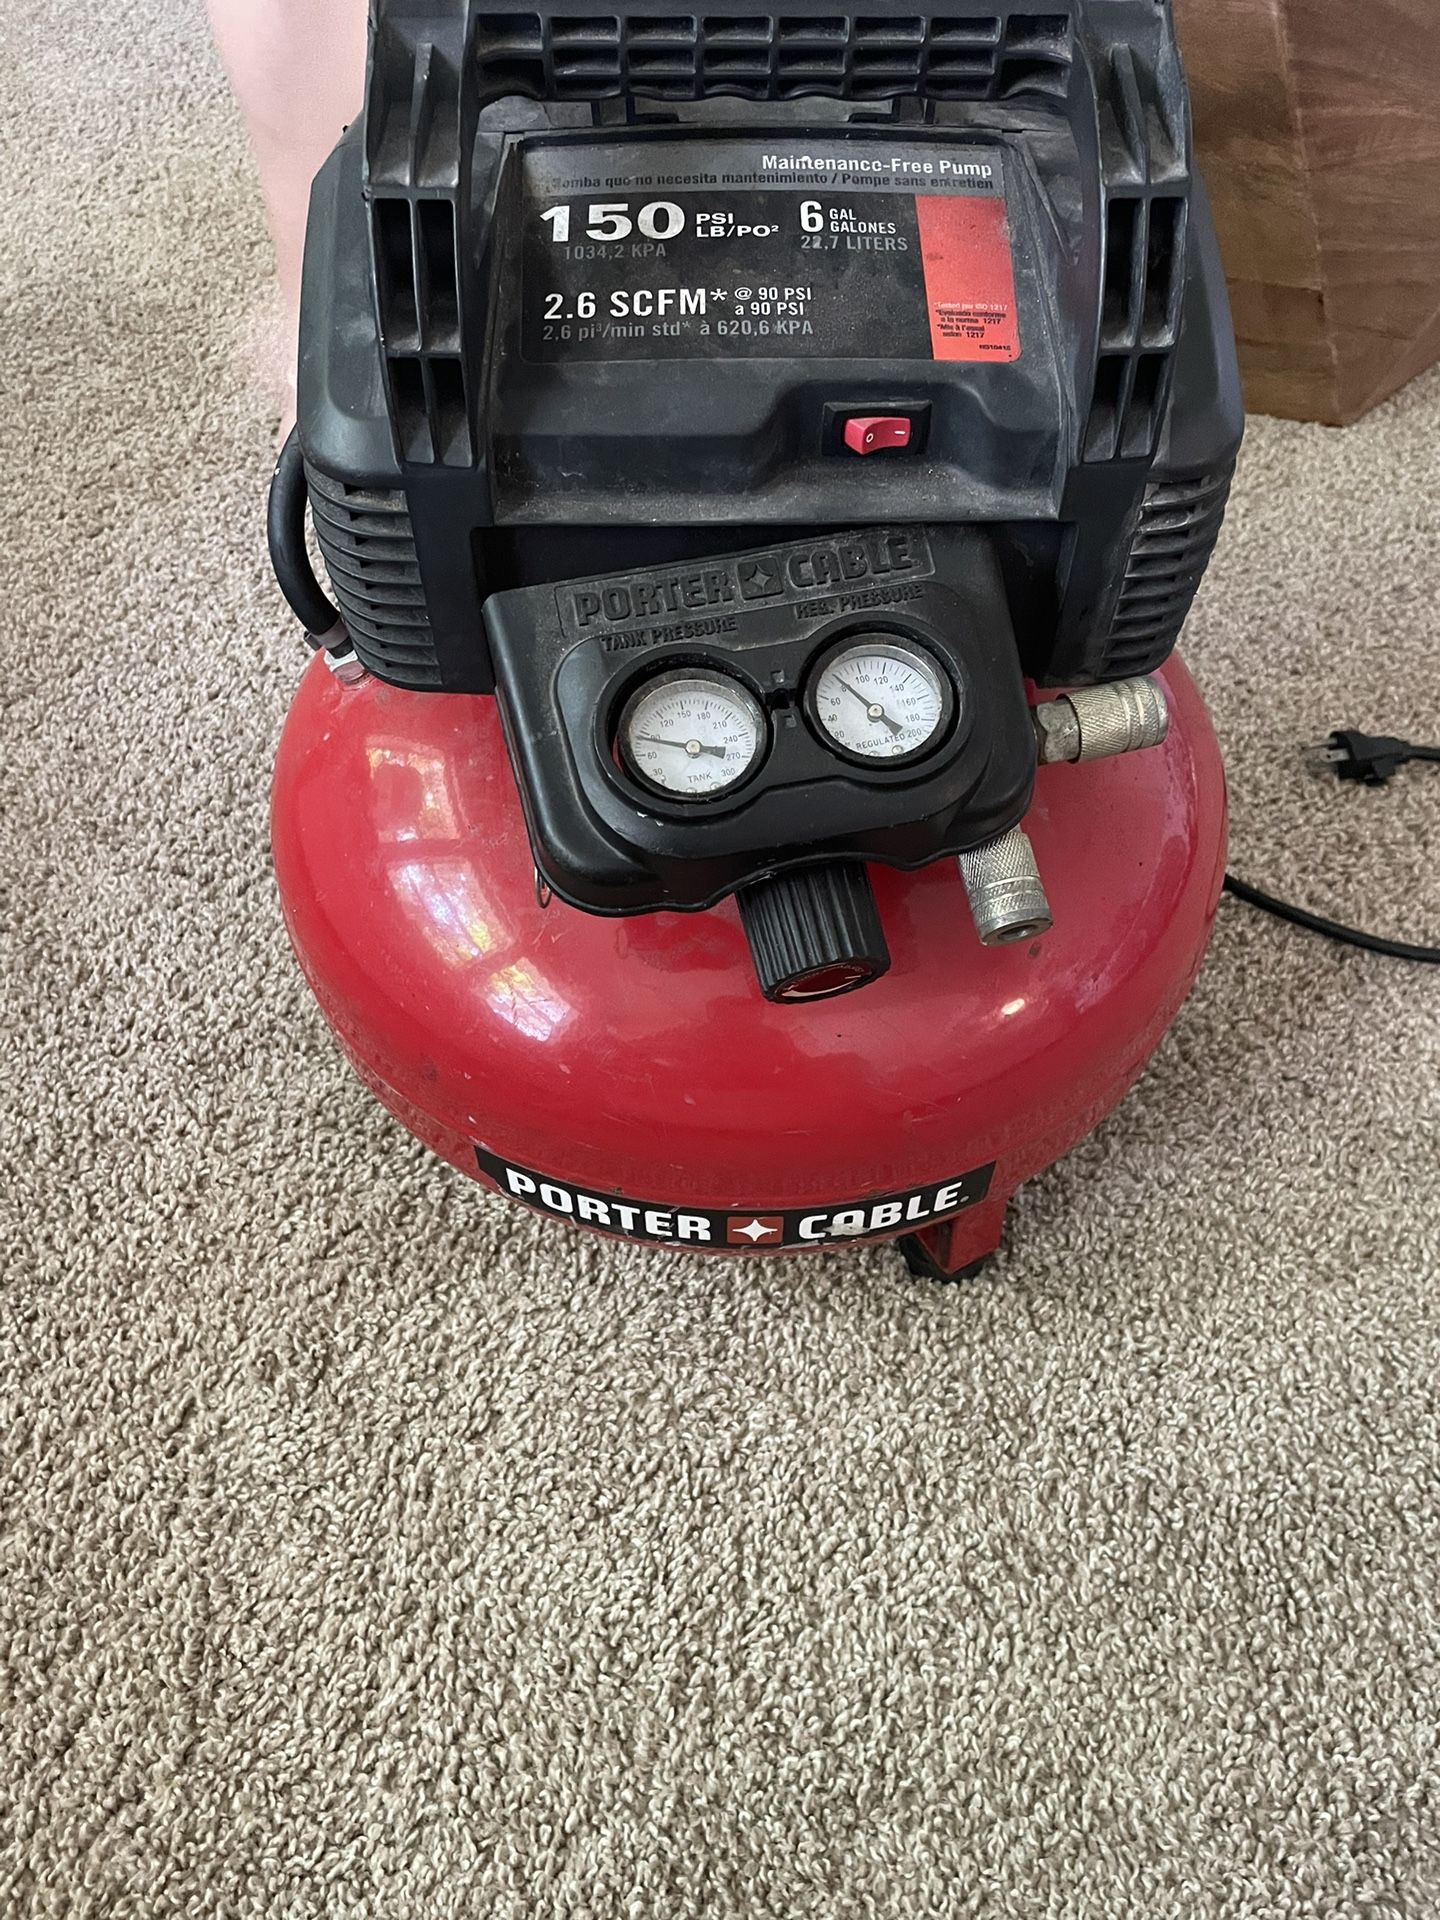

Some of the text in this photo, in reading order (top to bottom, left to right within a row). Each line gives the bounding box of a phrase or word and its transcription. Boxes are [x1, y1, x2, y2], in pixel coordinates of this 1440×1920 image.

[762, 155, 992, 178] Maintenance-Free Pump
[605, 175, 631, 189] que
[635, 175, 653, 186] no
[657, 173, 717, 186] necesita
[722, 171, 828, 185] mantenimiento
[842, 173, 890, 188] Pompe
[895, 176, 926, 187] sans
[931, 176, 993, 190] entretien
[696, 213, 734, 225] PSI
[800, 200, 824, 233] 6
[830, 209, 857, 221] GAL
[540, 201, 686, 242] 150
[830, 221, 896, 234] GALONES
[846, 236, 908, 251] LITERS
[564, 243, 667, 261] 1034,2 KPA
[734, 287, 812, 300] @ 90 PSI
[543, 292, 596, 320] 2.6
[735, 302, 805, 316] a 90 PSI
[543, 325, 571, 341] 2,6
[700, 319, 711, 335] à
[717, 320, 770, 337] 620,6
[776, 319, 814, 335] KPA
[574, 537, 914, 627] PORTER CABLE
[840, 584, 924, 613] PRESSURE
[601, 616, 737, 651] TANK PRESSURE
[856, 674, 870, 684] 100
[874, 676, 888, 686] 120
[890, 684, 904, 692] 140
[831, 697, 840, 706] 60
[902, 697, 916, 706] 160
[677, 710, 691, 718] 150
[697, 711, 711, 720] 180
[906, 713, 920, 723] 180
[660, 719, 674, 728] 120
[713, 721, 727, 729] 210
[907, 728, 922, 738] 200
[724, 735, 738, 744] 240
[856, 734, 905, 750] REGULATED
[648, 751, 657, 760] 60
[726, 752, 740, 761] 270
[653, 768, 663, 777] 30
[687, 771, 712, 783] TANK
[721, 768, 736, 777] 300
[504, 1166, 712, 1241] PORTER
